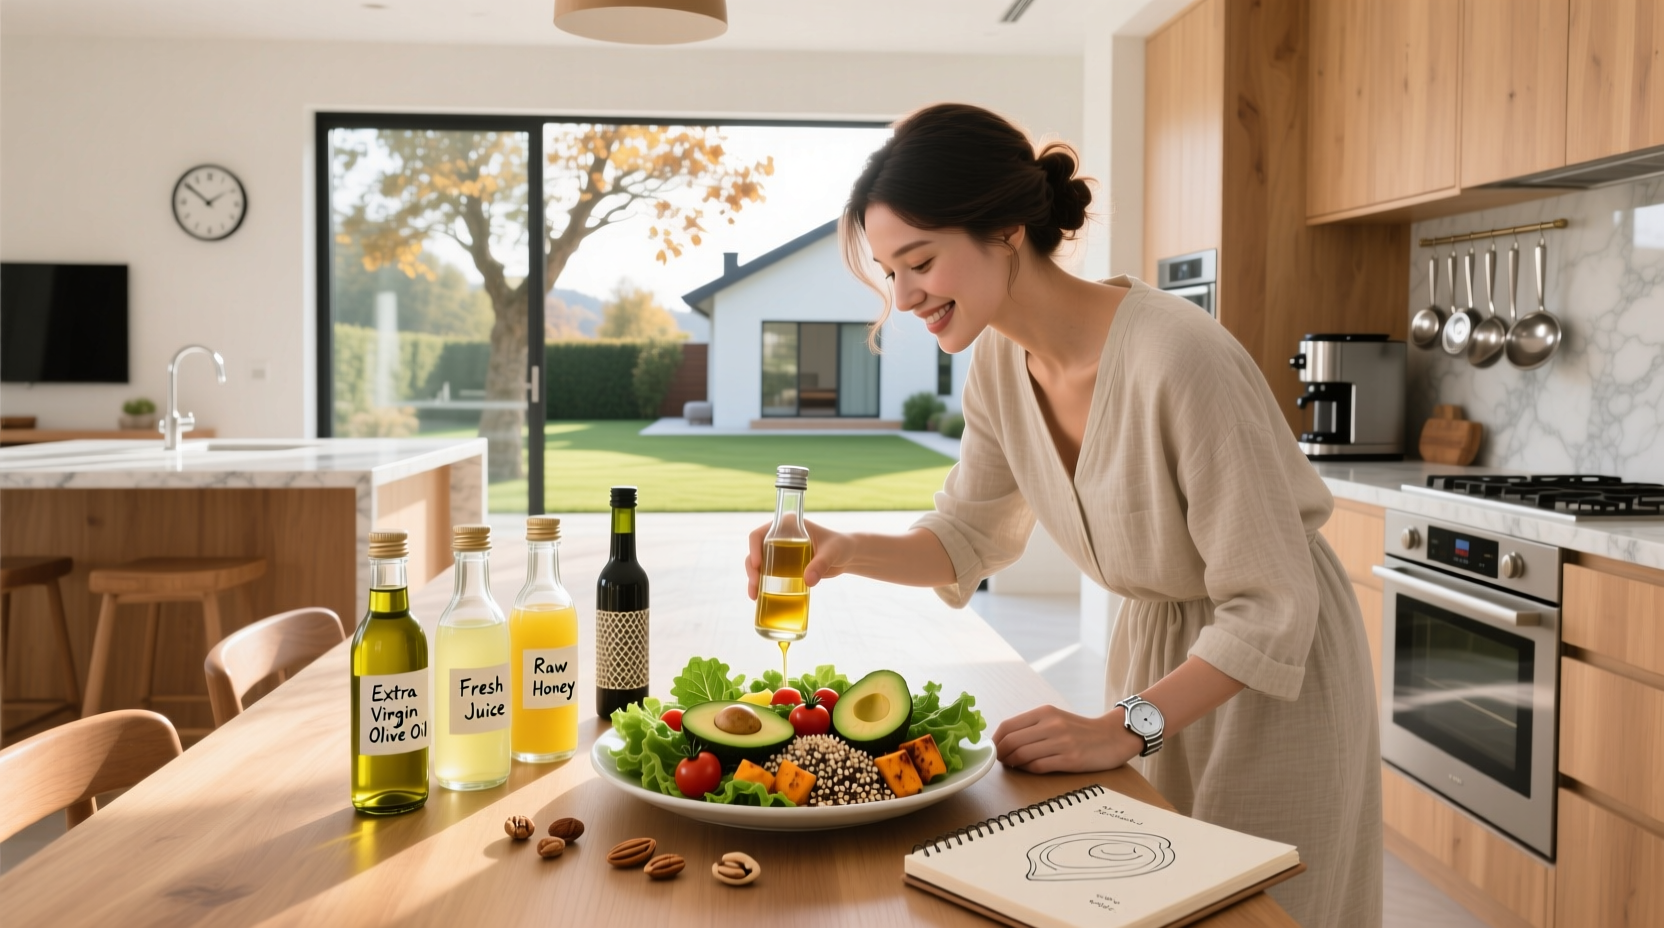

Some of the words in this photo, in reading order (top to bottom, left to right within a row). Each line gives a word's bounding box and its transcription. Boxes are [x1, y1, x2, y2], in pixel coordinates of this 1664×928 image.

[534, 657, 568, 674] Raw
[372, 685, 418, 702] Extra
[460, 675, 503, 697] Fresh
[532, 680, 576, 701] Honey
[371, 705, 418, 729] Virgin
[464, 702, 505, 720] Juice
[369, 726, 406, 743] Olive
[410, 721, 427, 740] Oil
